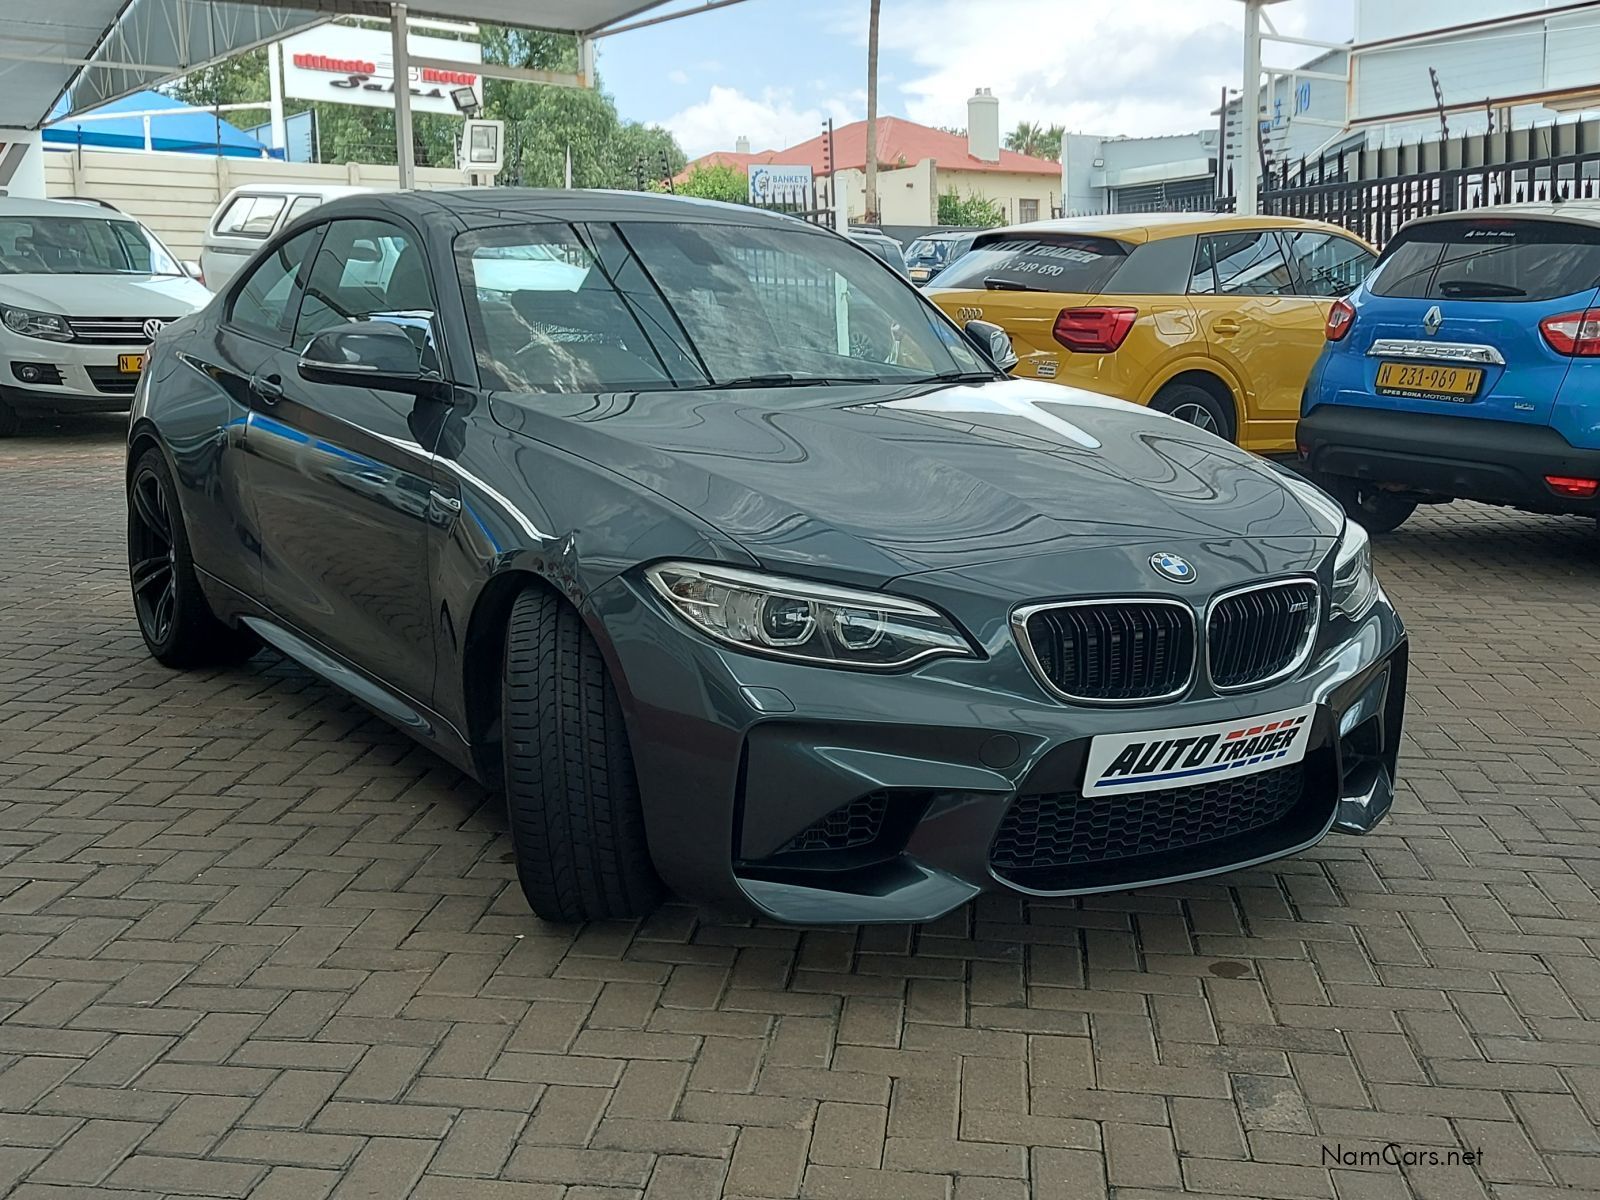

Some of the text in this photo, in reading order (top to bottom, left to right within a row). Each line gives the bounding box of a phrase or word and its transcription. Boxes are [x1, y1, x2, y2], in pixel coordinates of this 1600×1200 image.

[293, 53, 477, 86] ultimate motor
[329, 74, 445, 99] Saes
[772, 175, 809, 184] BANKETS
[1025, 245, 1103, 264] TRADER
[1014, 261, 1039, 274] 249
[1037, 263, 1065, 277] 690
[121, 356, 129, 370] N
[1380, 366, 1393, 385] N
[1398, 367, 1457, 389] 231-969
[1422, 393, 1451, 401] MOTOR
[1101, 726, 1301, 778] AUTO TRADER
